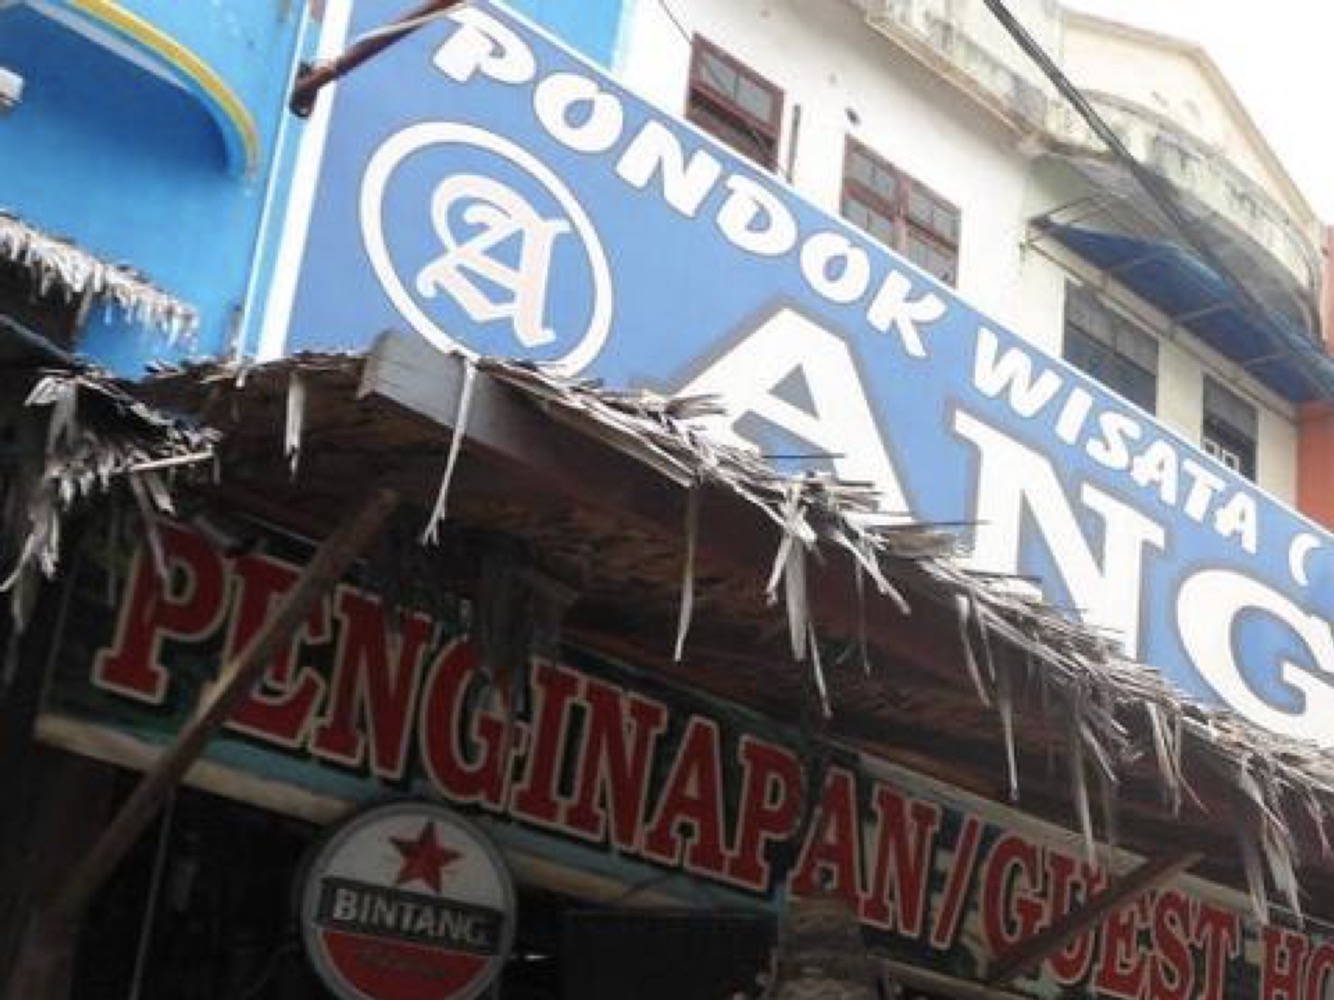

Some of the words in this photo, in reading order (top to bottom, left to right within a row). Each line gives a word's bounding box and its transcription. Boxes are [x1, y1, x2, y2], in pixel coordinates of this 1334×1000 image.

[432, 12, 948, 358] PONDOK
[972, 326, 1261, 556] WISATA
[332, 887, 495, 945] BINTANG
